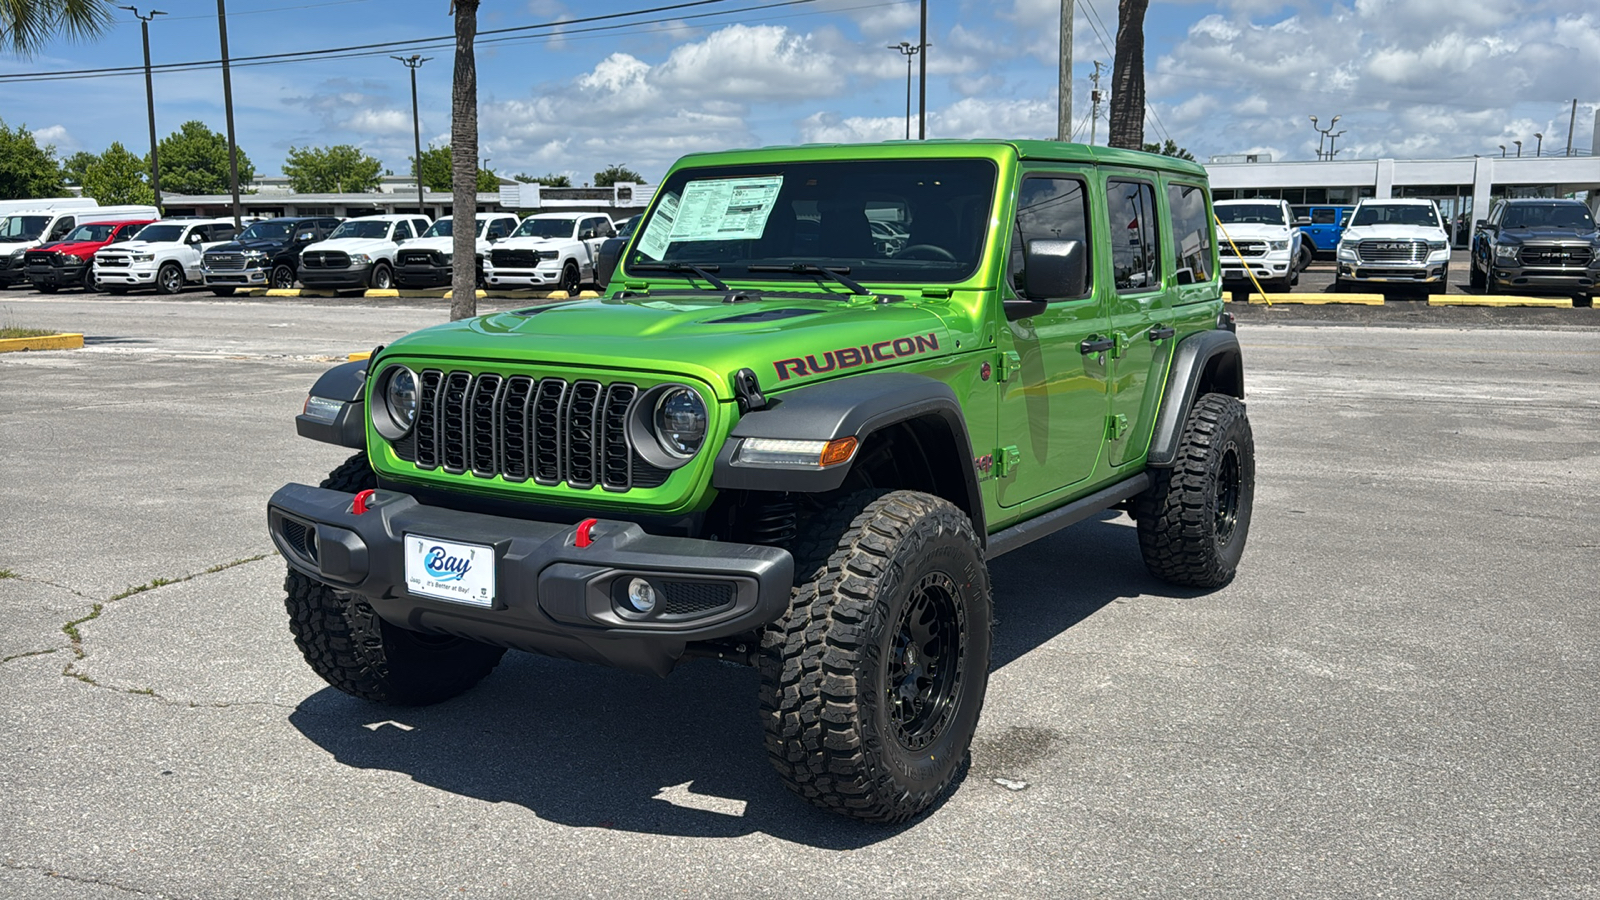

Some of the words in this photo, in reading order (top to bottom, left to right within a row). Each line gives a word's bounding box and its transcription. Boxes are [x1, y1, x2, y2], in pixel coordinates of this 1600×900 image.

[773, 333, 940, 381] RUBICON
[427, 546, 472, 581] Bay
[435, 582, 451, 590] Better
[458, 586, 470, 594] Bay!
